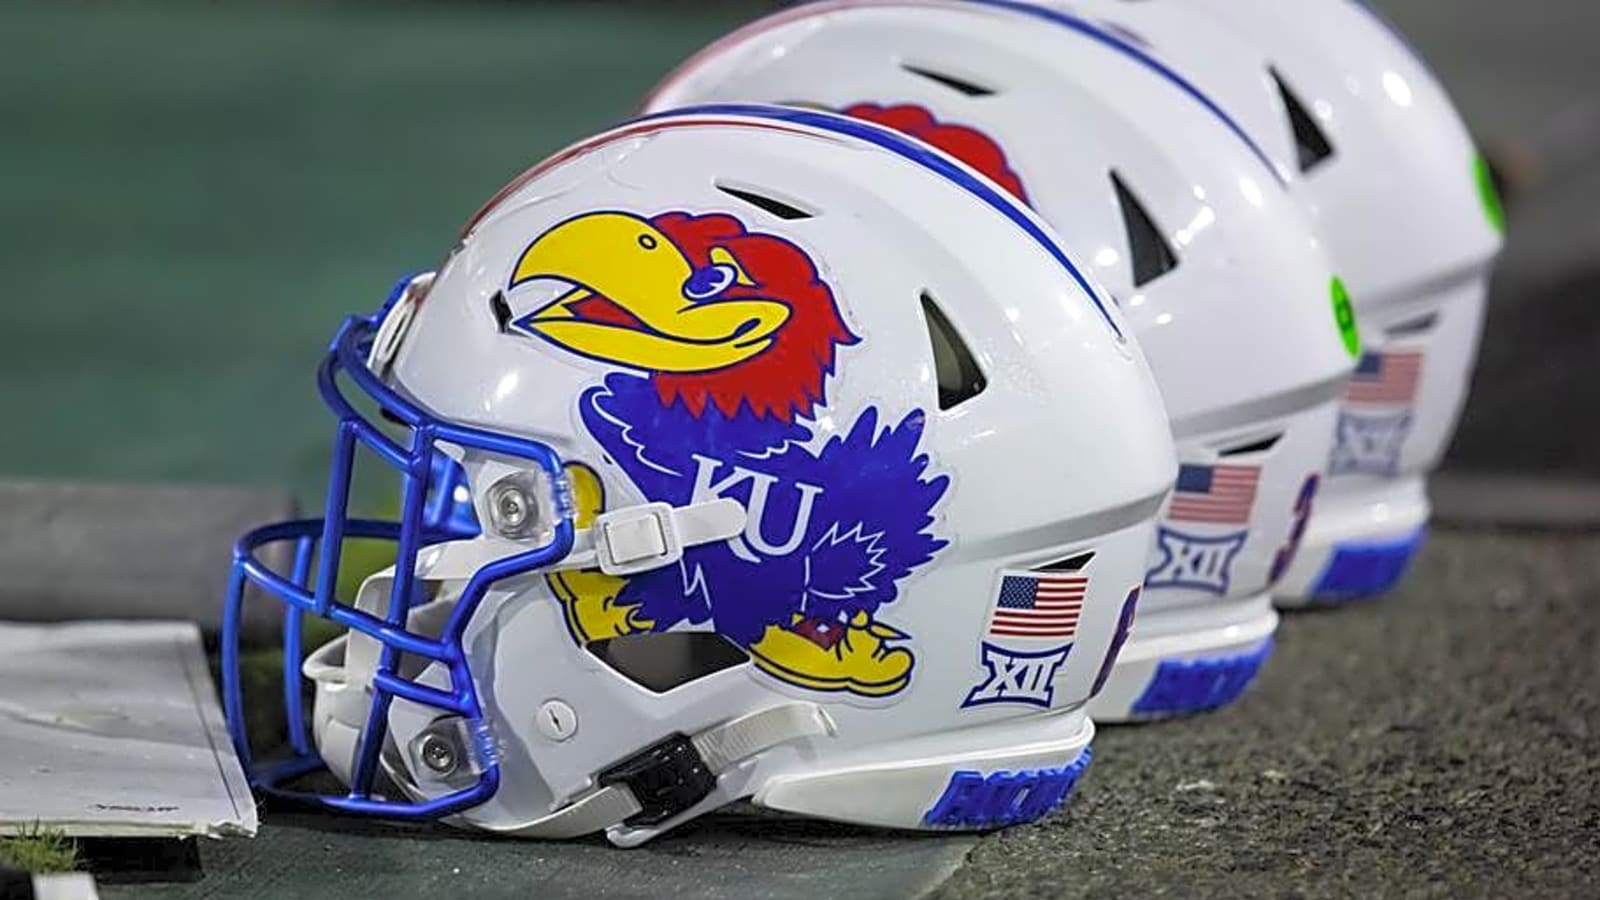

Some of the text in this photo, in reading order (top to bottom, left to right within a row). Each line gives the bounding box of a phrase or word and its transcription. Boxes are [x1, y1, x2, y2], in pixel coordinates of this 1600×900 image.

[692, 453, 824, 563] KU
[1144, 527, 1247, 595] XII
[963, 643, 1072, 707] XII
